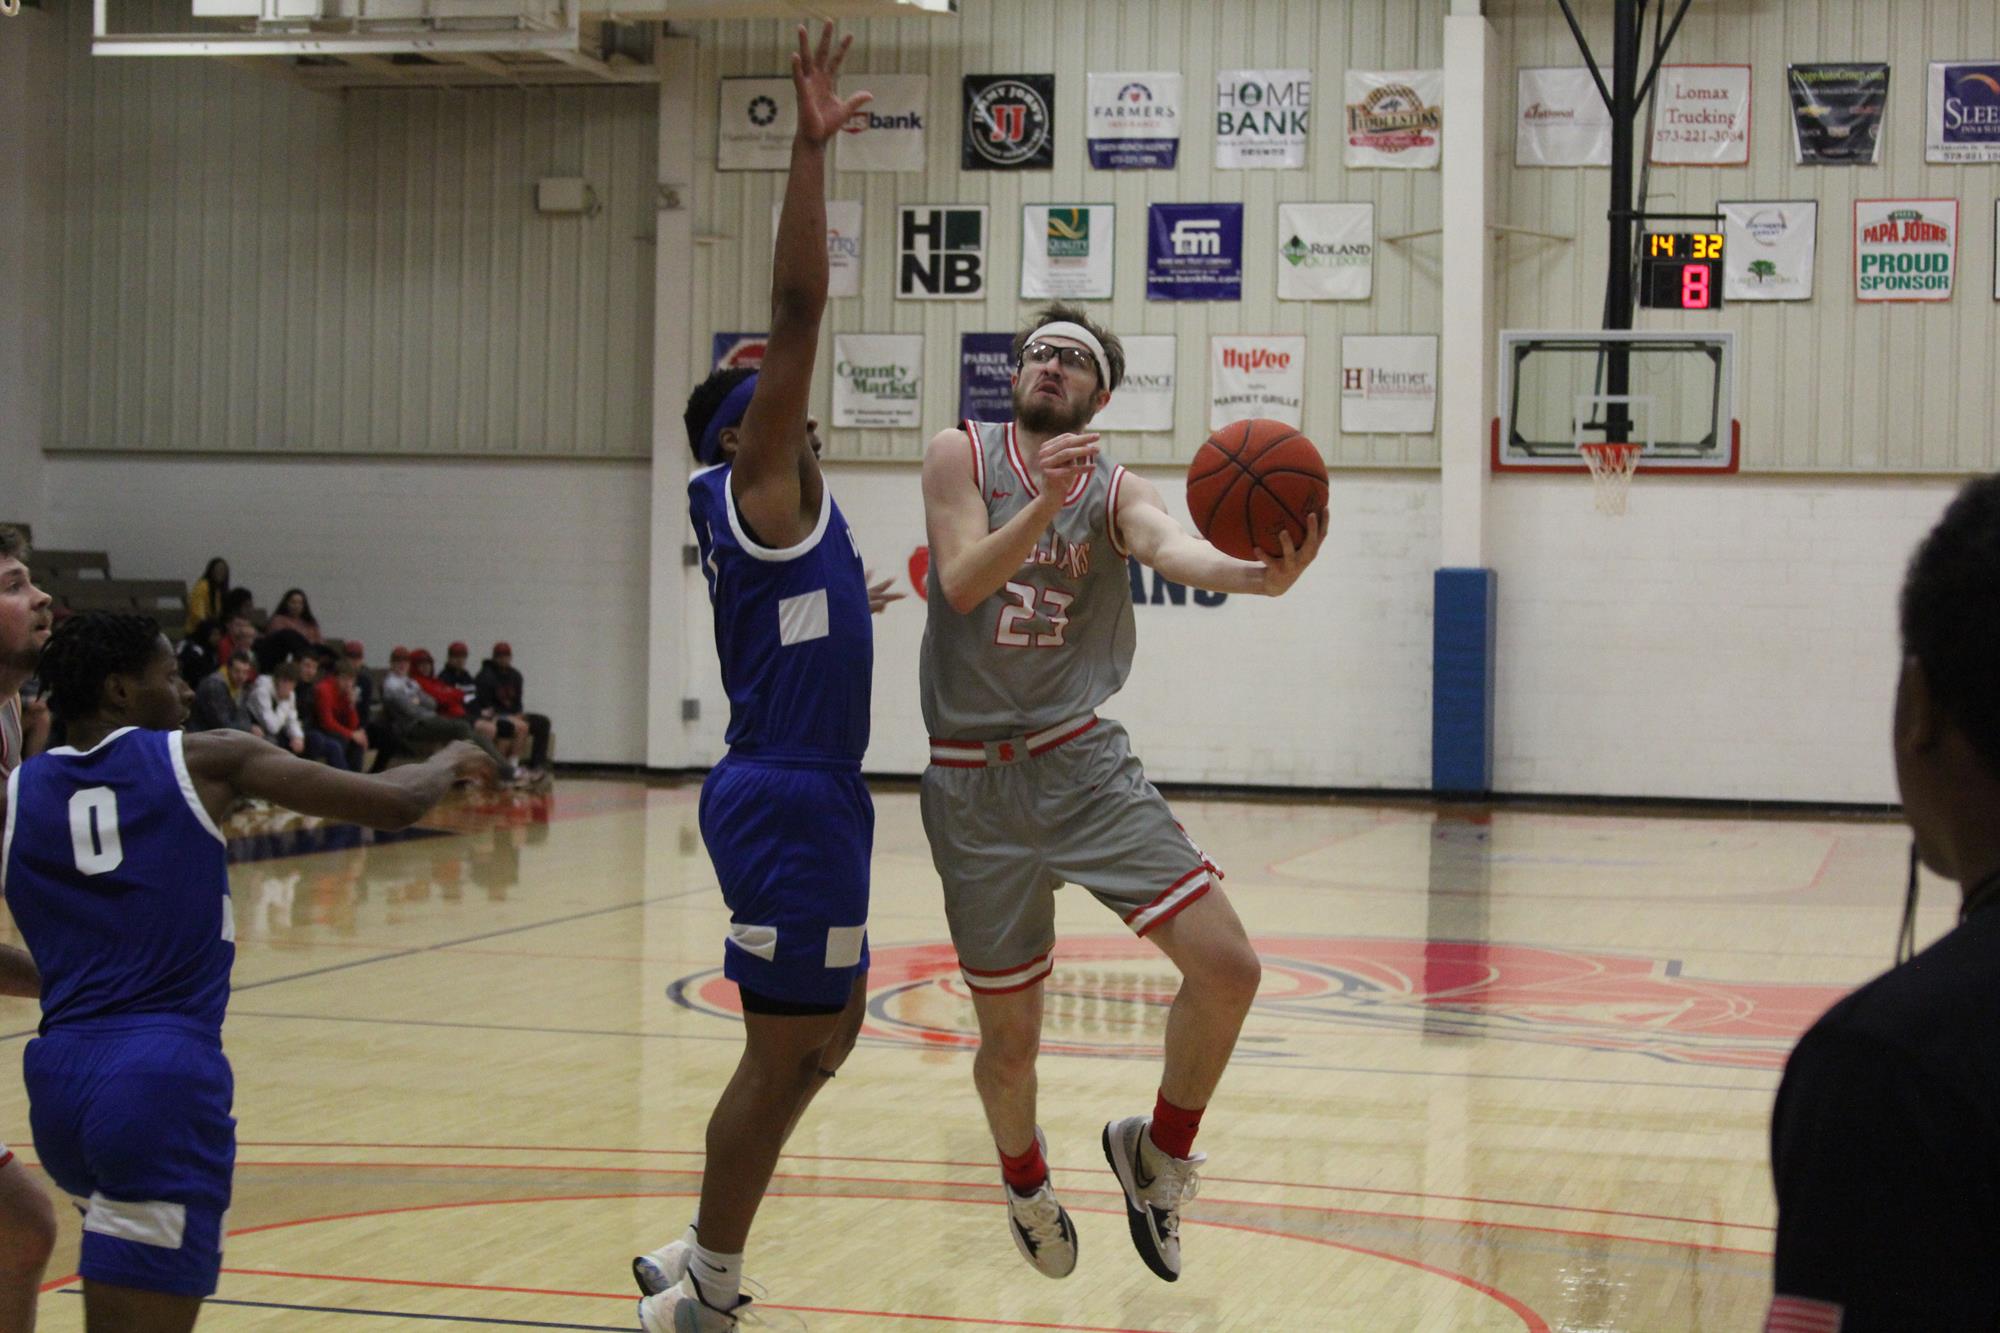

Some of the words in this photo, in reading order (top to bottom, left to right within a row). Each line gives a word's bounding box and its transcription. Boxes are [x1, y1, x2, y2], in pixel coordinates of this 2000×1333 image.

[1216, 81, 1311, 107] HOME
[1675, 83, 1729, 100] Lomax
[1094, 106, 1176, 118] FARMERS
[1217, 111, 1308, 136] BANK
[1665, 107, 1736, 130] Trucking
[1945, 96, 2000, 130] SLEE
[1864, 222, 1899, 243] PAPA
[1311, 243, 1371, 256] ROLAND
[1651, 233, 1675, 257] 14
[1692, 233, 1724, 259] 32
[1861, 253, 1949, 273] PROUD
[1682, 264, 1710, 309] 8
[1860, 275, 1949, 290] SPONSOR
[837, 361, 907, 382] County
[1343, 367, 1363, 391] H
[851, 378, 917, 394] Market
[994, 580, 1075, 647] 23
[68, 785, 124, 877] 0
